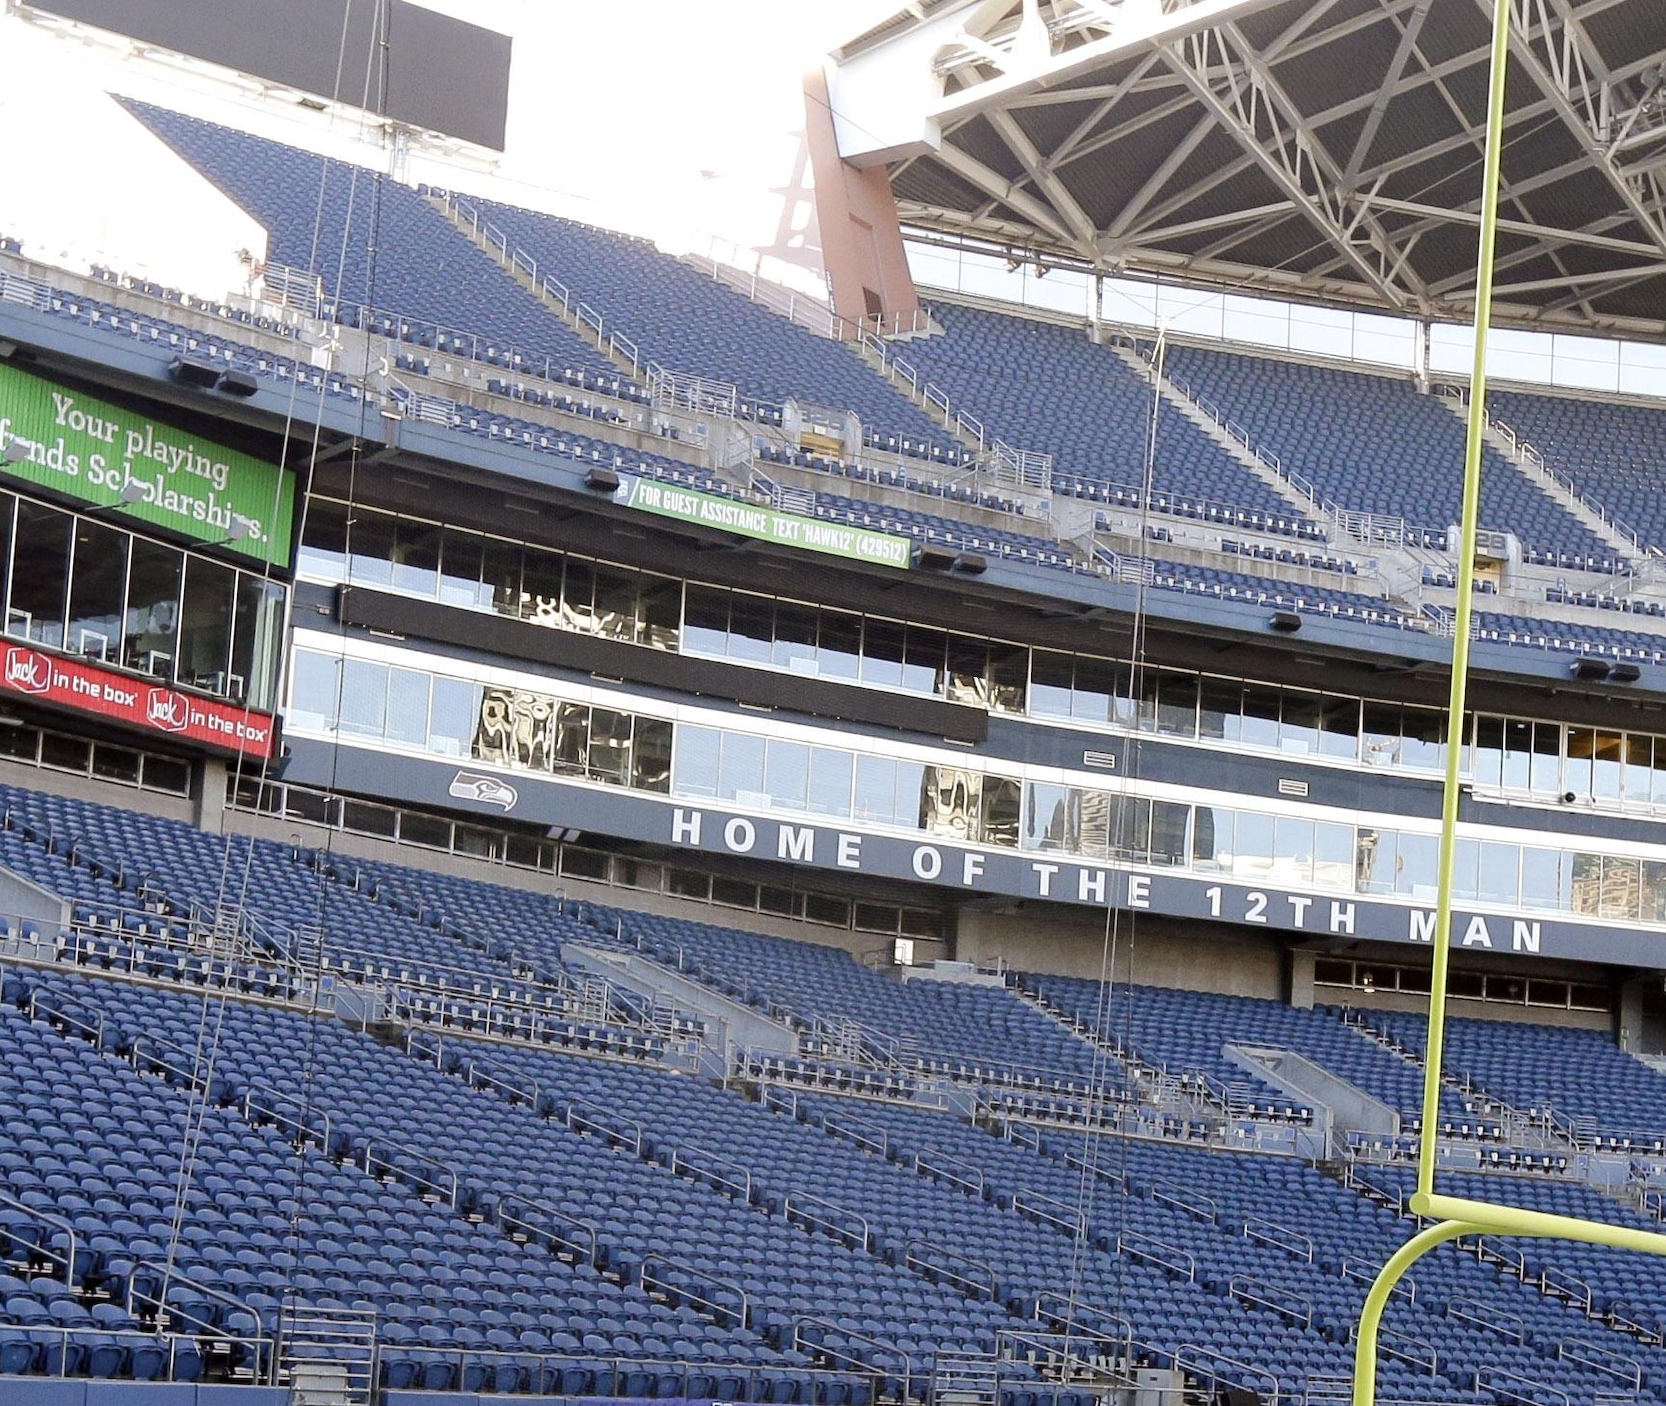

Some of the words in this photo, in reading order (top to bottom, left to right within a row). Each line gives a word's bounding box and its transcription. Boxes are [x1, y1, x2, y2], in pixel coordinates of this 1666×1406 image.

[52, 392, 119, 444] Your
[126, 425, 230, 491] playing
[88, 454, 269, 543] Scholarshis.
[639, 484, 661, 508] FOR
[663, 491, 699, 517] GUEST
[700, 500, 766, 534] ASSISTANCE
[772, 518, 800, 541] TEXT
[802, 524, 856, 551] 'HAWK12'
[856, 538, 907, 564] (429512)
[7, 650, 47, 687] Jack
[53, 670, 69, 688] in
[72, 675, 100, 696] the
[104, 682, 135, 706] box
[149, 691, 185, 726] Jack
[191, 708, 205, 725] in
[208, 712, 234, 734] the
[237, 718, 266, 742] box
[671, 809, 862, 868] HOME
[912, 846, 985, 885] OF
[1032, 863, 1151, 909] THE
[1205, 886, 1356, 935] 12TH
[1408, 912, 1541, 954] MAN
